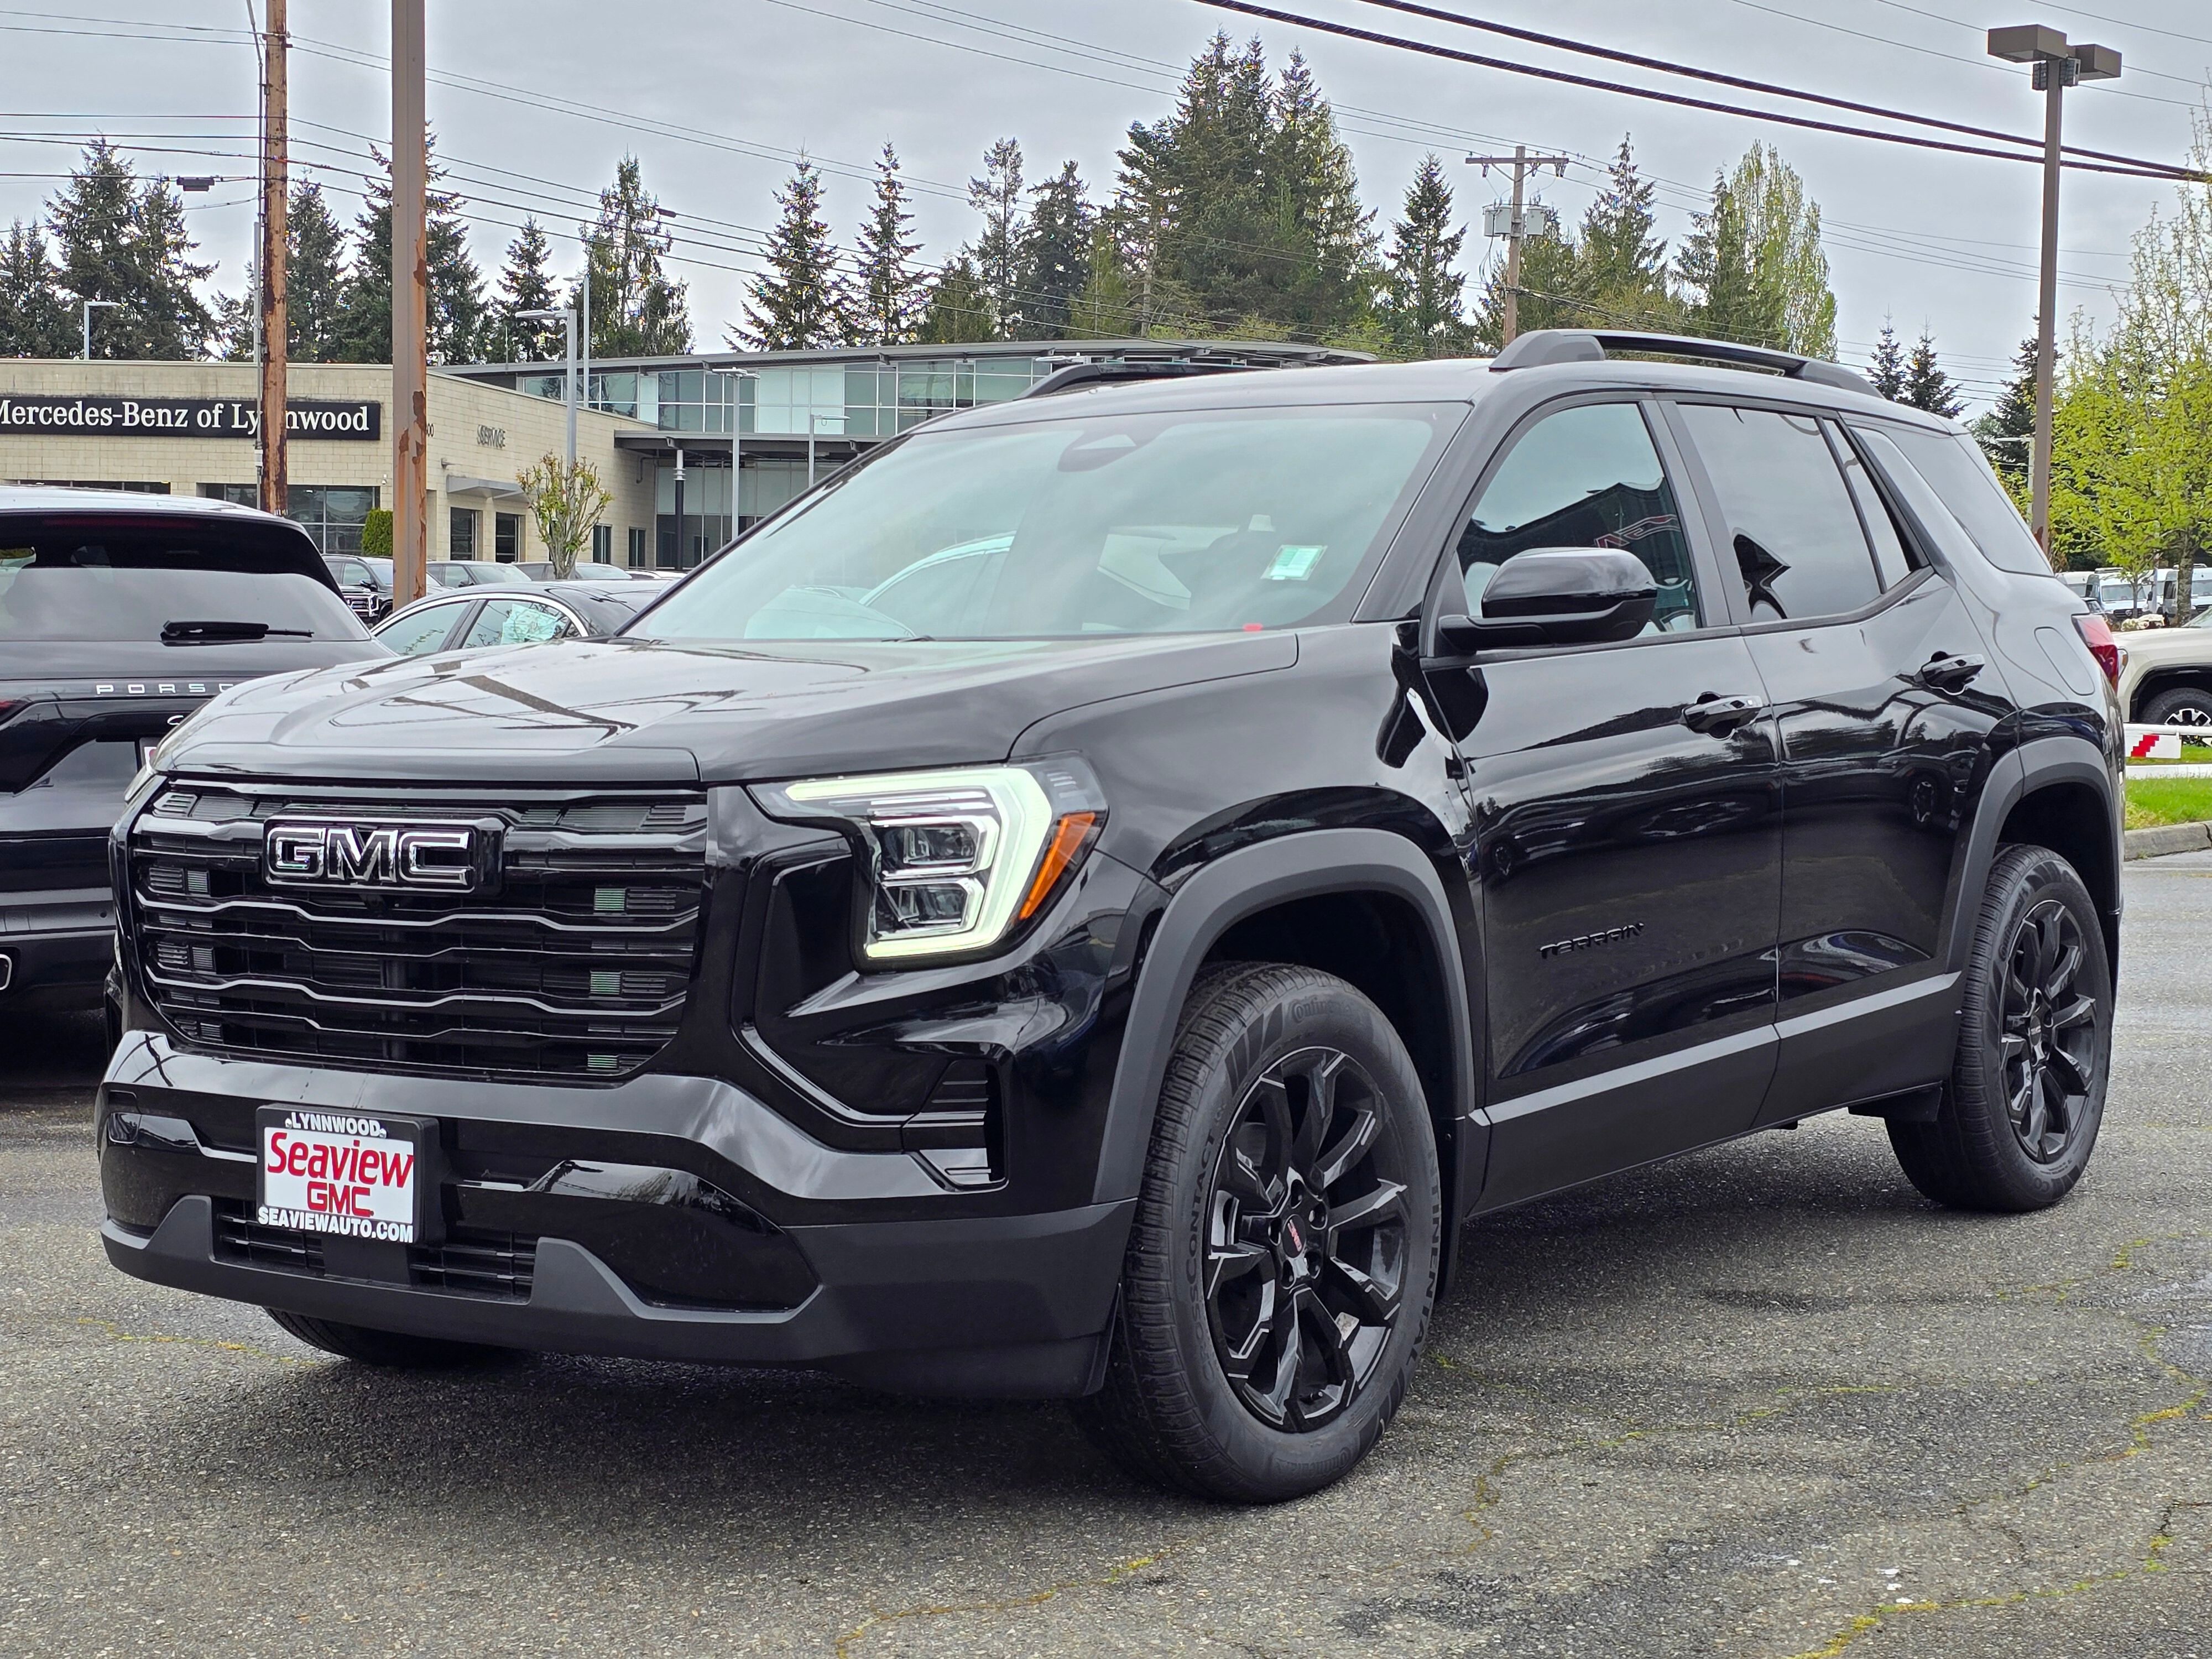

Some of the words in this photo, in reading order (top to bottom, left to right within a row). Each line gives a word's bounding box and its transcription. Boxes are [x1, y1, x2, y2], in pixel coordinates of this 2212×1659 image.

[0, 399, 189, 427] Mercedes-Benz
[197, 403, 224, 429] of
[231, 403, 369, 435] Lynwood
[476, 424, 505, 448] SERVICE
[267, 826, 473, 886] GMC
[291, 1112, 380, 1137] LYNNWOOD
[267, 1131, 414, 1188] Seaview
[307, 1181, 372, 1217] GMC
[258, 1207, 413, 1244] SEAVIEWAUTO.COM
